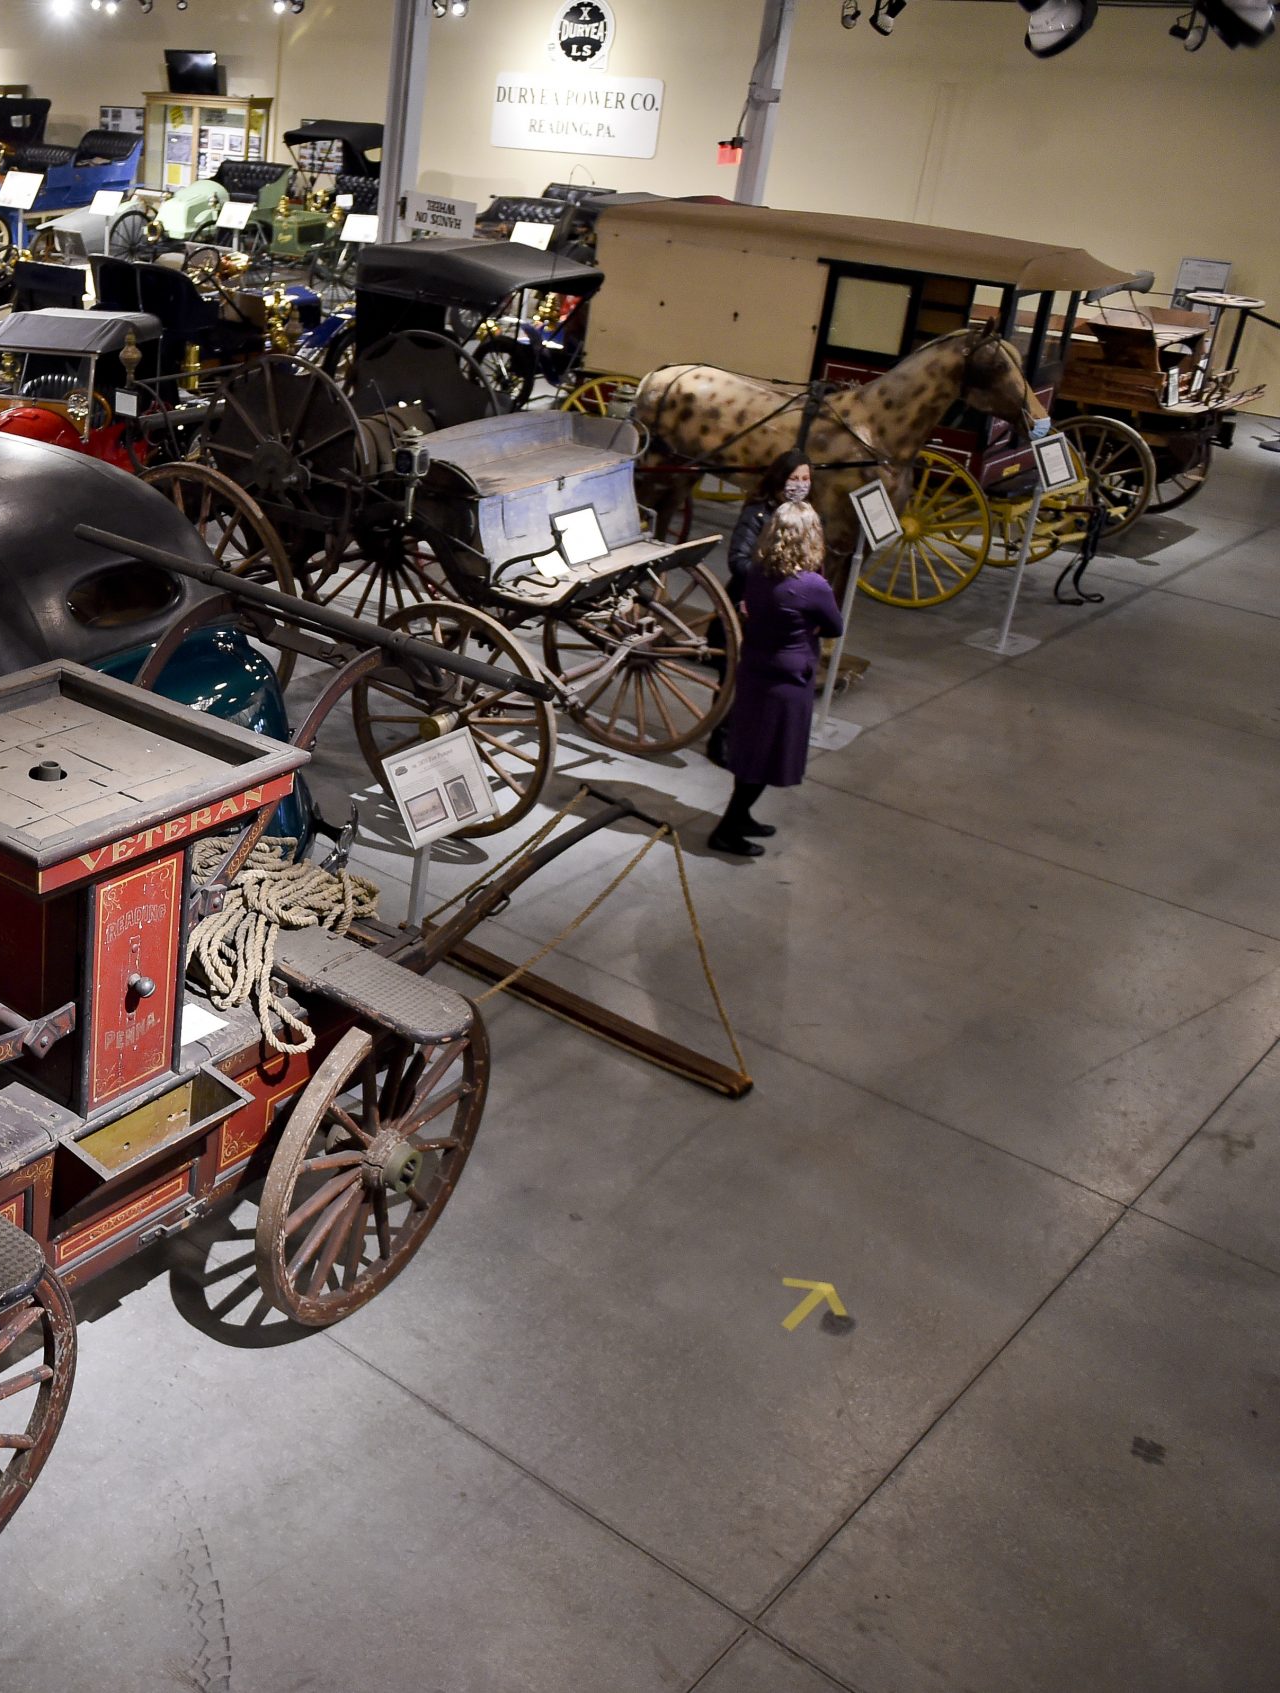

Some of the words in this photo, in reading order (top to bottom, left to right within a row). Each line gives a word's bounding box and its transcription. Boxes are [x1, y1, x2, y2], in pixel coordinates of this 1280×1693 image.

[578, 7, 592, 21] X
[560, 20, 606, 42] DURYEA
[496, 86, 560, 106] DURYEA
[566, 90, 625, 110] POWER
[630, 93, 659, 112] CO.
[596, 122, 616, 138] PA.
[426, 200, 456, 215] WHEEL
[415, 211, 428, 223] ON
[430, 214, 462, 230] HANDS
[77, 785, 265, 872] VETERAN
[106, 903, 167, 944] READING
